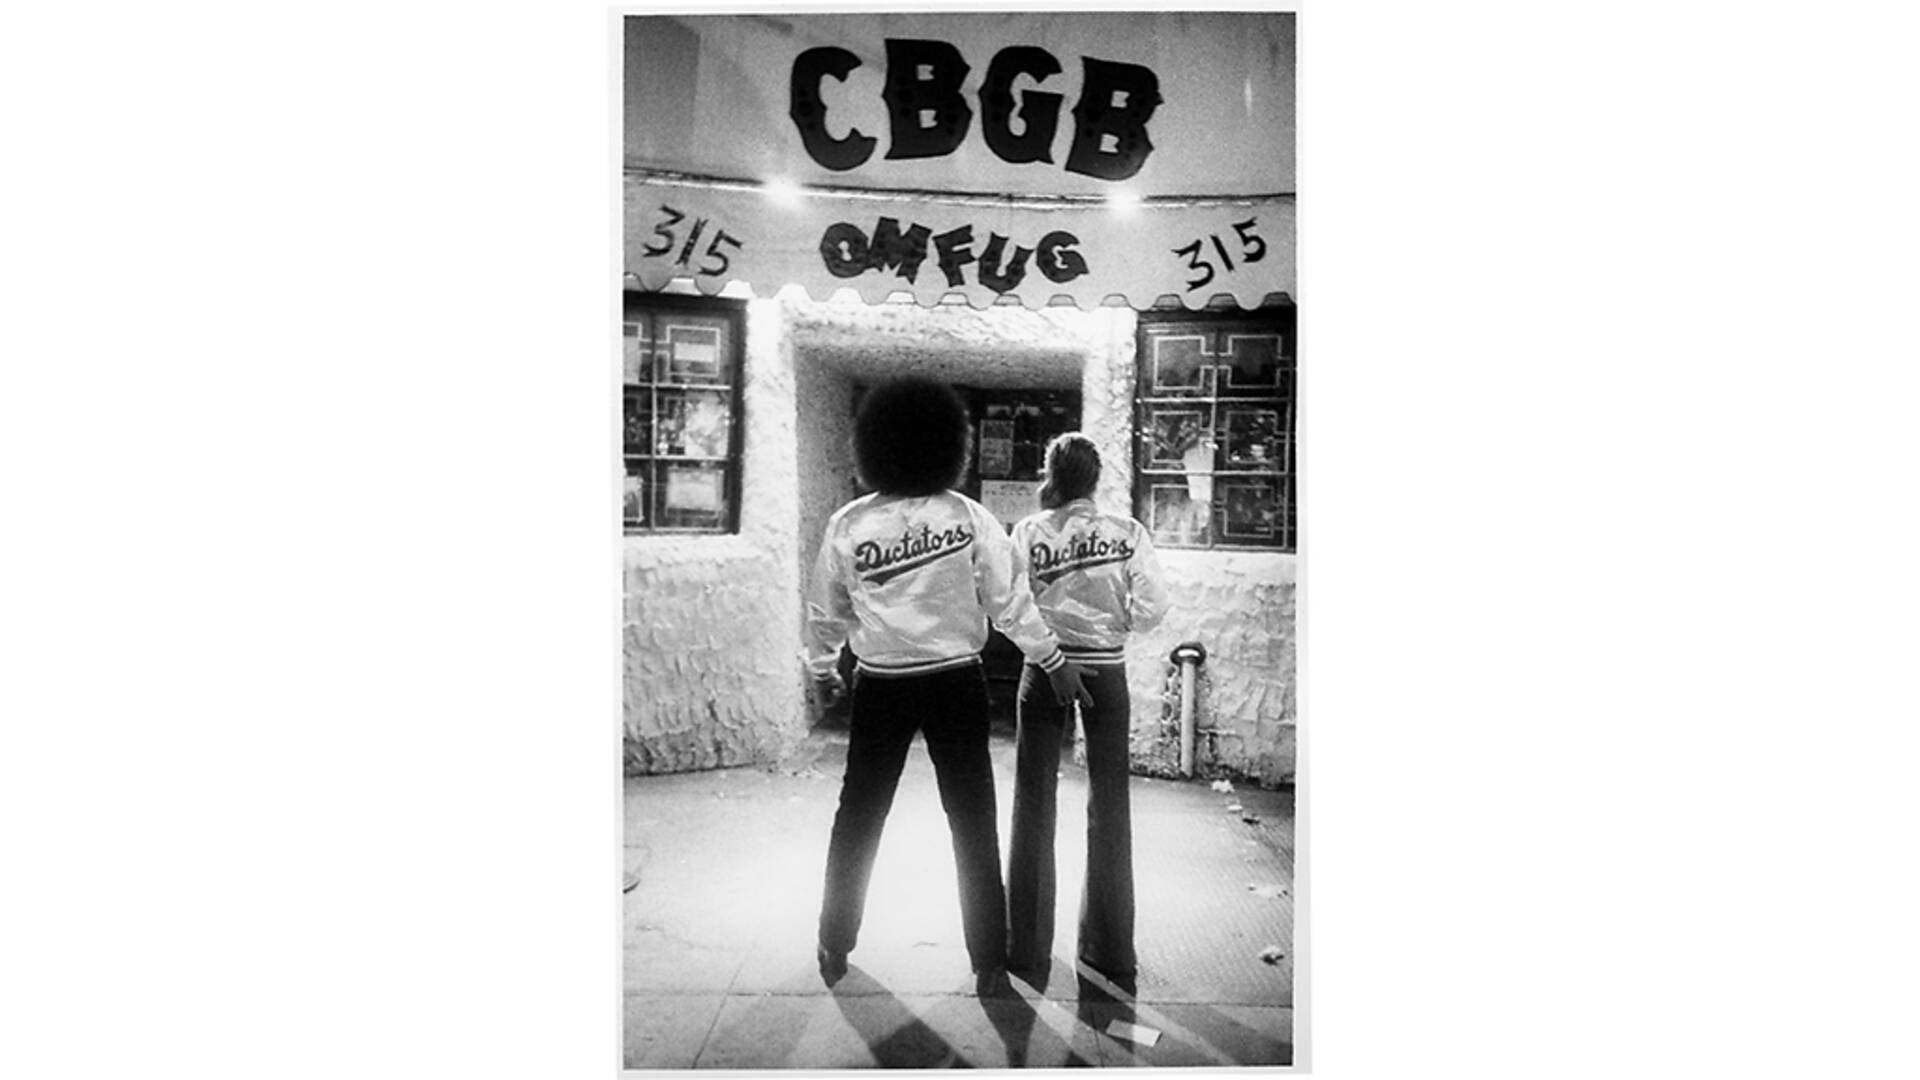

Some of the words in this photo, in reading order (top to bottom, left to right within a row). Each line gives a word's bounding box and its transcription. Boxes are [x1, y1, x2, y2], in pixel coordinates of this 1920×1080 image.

[790, 38, 1164, 180] CBGB
[643, 204, 742, 277] 315
[820, 216, 1089, 295] OMFUG
[1172, 217, 1266, 290] 315
[854, 525, 973, 574] Dictators
[1030, 529, 1134, 572] Dictators
